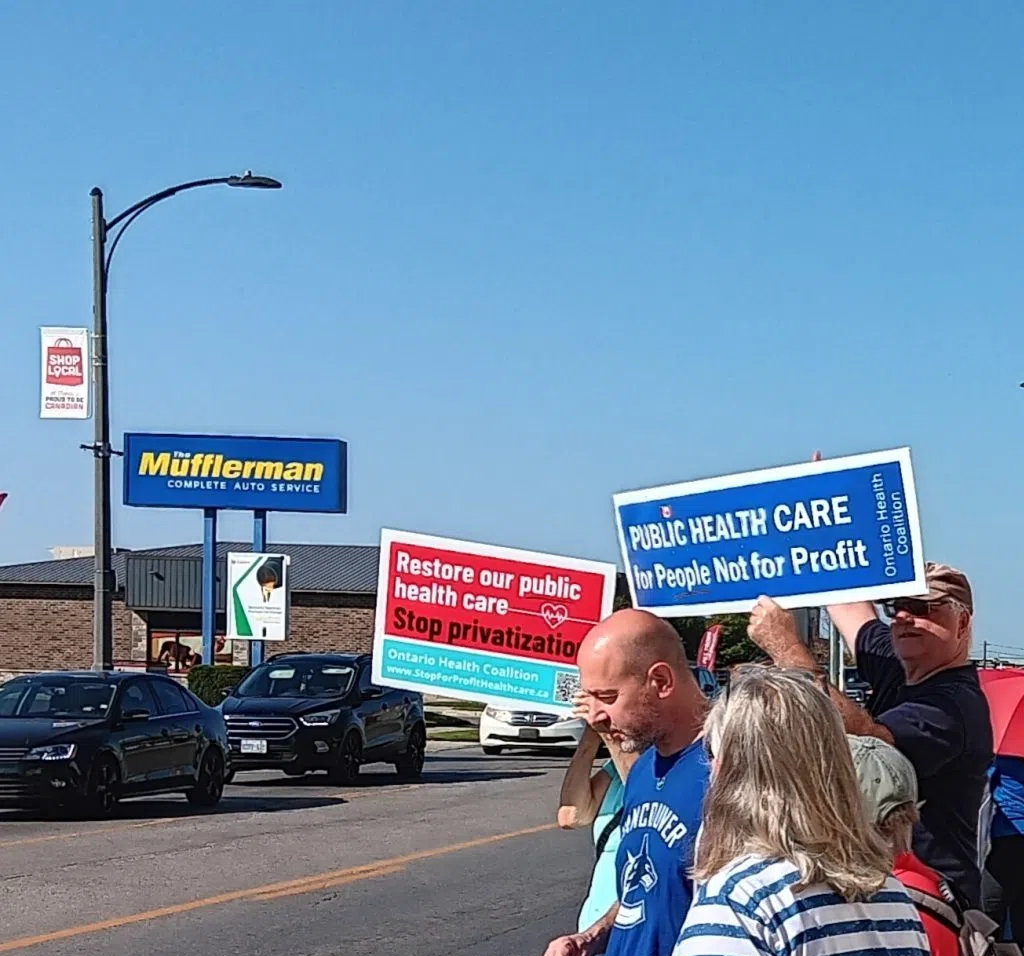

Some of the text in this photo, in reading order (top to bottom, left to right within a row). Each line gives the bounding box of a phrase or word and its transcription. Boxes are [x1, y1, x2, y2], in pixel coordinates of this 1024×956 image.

[48, 354, 81, 366] SHOP
[48, 366, 82, 378] LOCAL
[138, 452, 324, 481] Mufflerman
[167, 479, 321, 493] COMPLETE AUTO SERVICE
[629, 495, 852, 551] PUBLIC HEALTH CARE
[872, 472, 897, 577] Ontario Health
[890, 491, 908, 555] Coalition
[396, 551, 582, 600] Restore our public
[634, 539, 870, 592] for People Not for Profit
[394, 577, 509, 616] health care
[393, 606, 580, 658] Stop privatizatio
[387, 665, 549, 699] www.StopForProfitHealthcare.ca
[388, 648, 539, 682] Ontario Health Coalition
